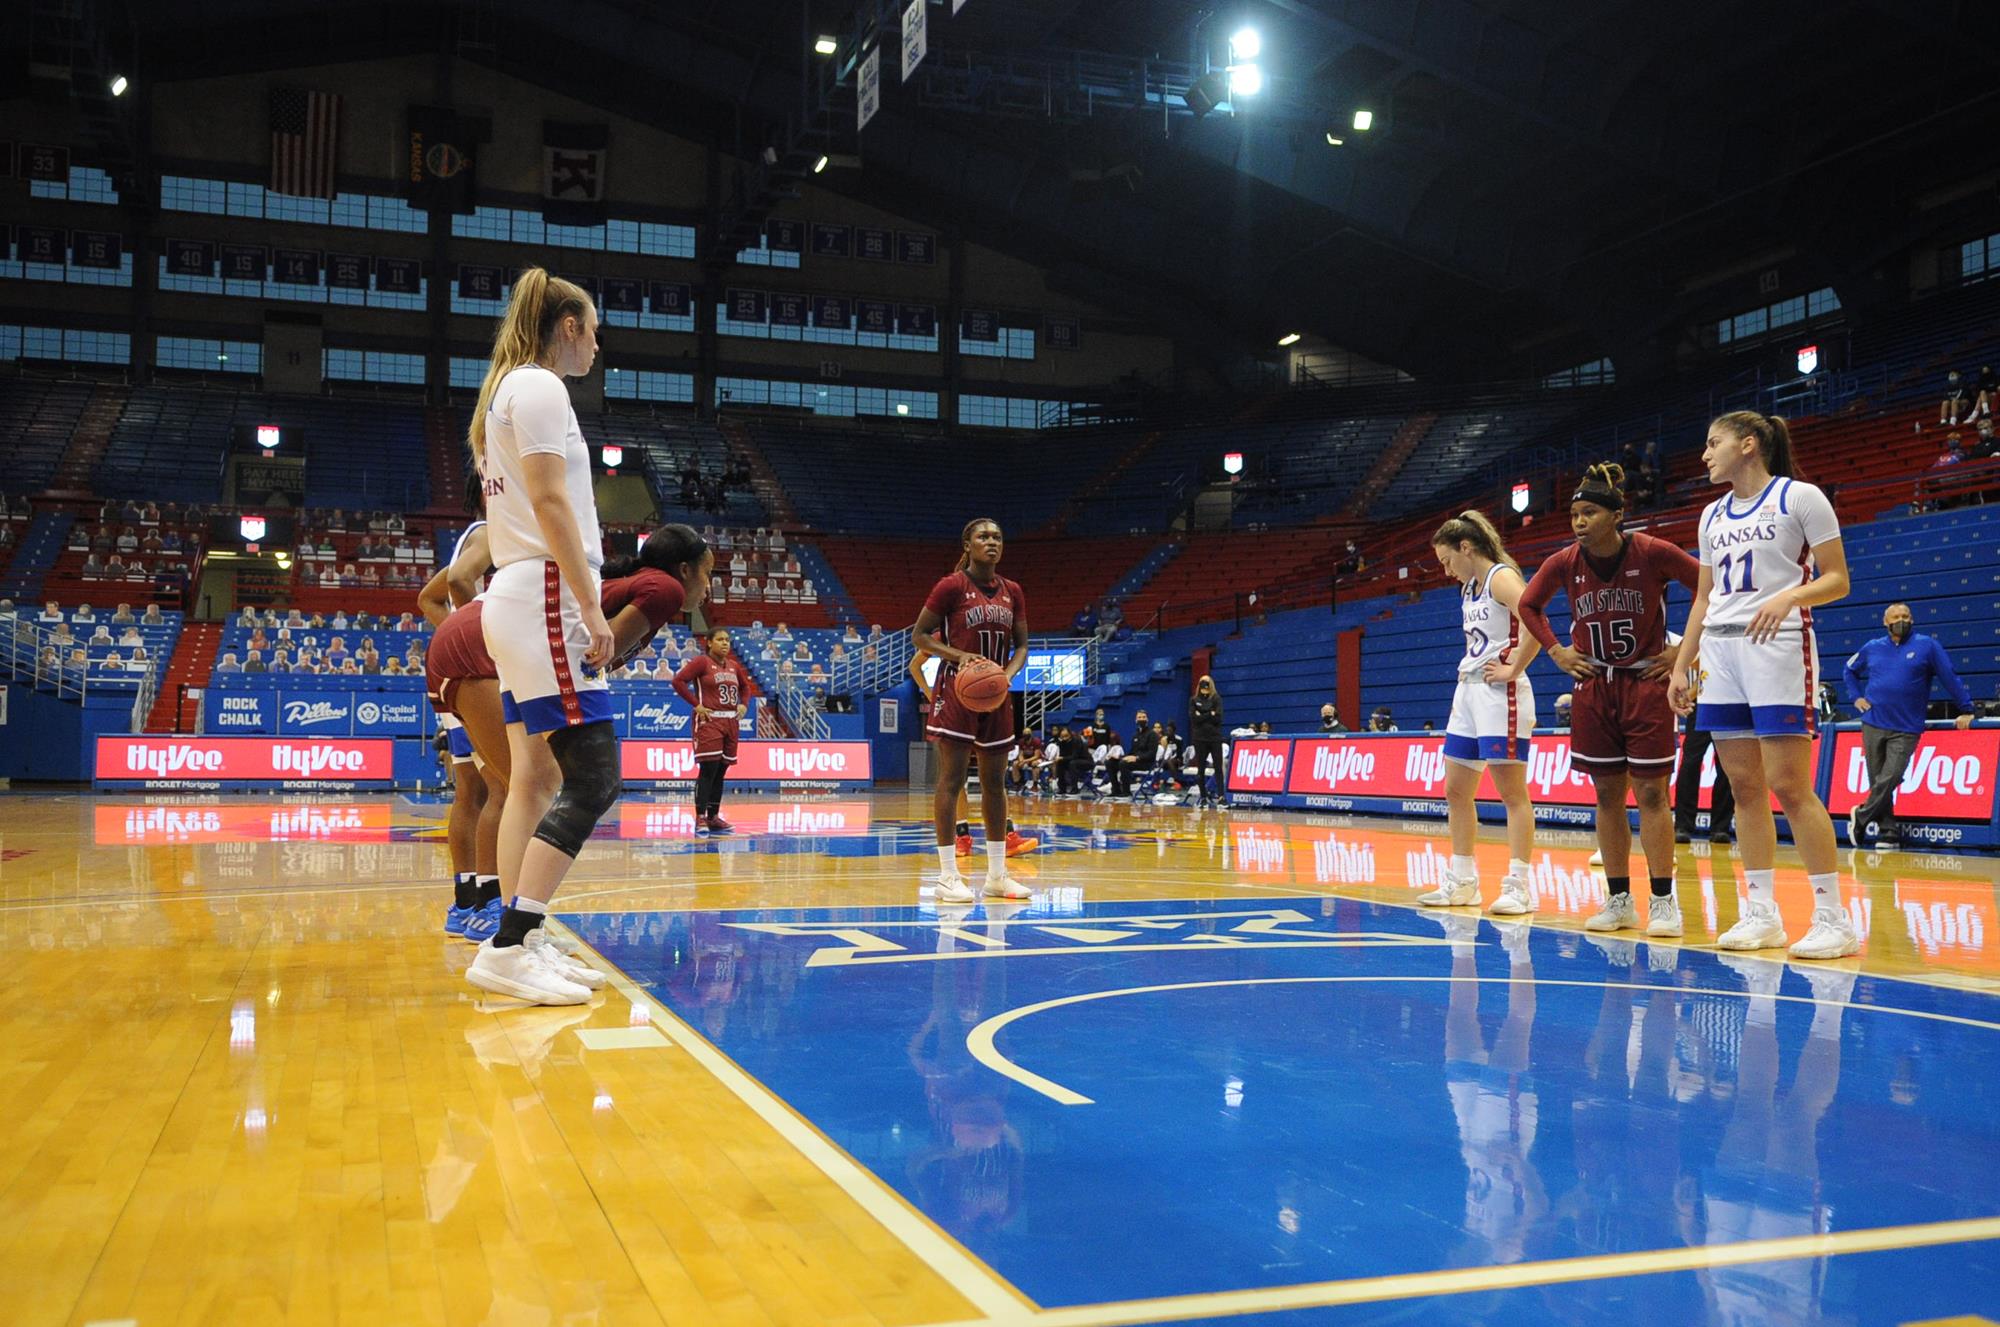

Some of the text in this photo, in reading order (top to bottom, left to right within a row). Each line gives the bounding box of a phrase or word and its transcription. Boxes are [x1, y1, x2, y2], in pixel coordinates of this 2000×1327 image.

[410, 128, 425, 183] KANSAS
[33, 155, 55, 172] 33
[34, 238, 51, 254] 13
[826, 233, 836, 248] 7
[88, 242, 105, 259] 15
[181, 250, 202, 266] 40
[235, 256, 252, 271] 15
[288, 260, 305, 275] 14
[337, 264, 359, 280] 25
[392, 269, 405, 284] 11
[471, 276, 490, 290] 45
[617, 288, 627, 303] 4
[663, 292, 678, 307] 10
[737, 299, 756, 314] 23
[782, 303, 797, 317] 15
[823, 306, 841, 321] 25
[866, 311, 884, 325] 45
[912, 315, 920, 328] 4
[971, 320, 989, 334] 22
[1710, 524, 1776, 551] KANSAS
[1718, 549, 1759, 596] 11
[1576, 588, 1645, 620] NM STATE
[965, 605, 985, 629] NM
[1586, 618, 1637, 661] 15
[978, 630, 1005, 667] 11
[719, 683, 738, 706] 33
[223, 697, 258, 710] ROCK
[382, 704, 416, 715] Capitol
[218, 713, 262, 726] CHALK
[284, 701, 347, 726] Dillons
[382, 713, 416, 723] Federal
[145, 780, 220, 790] ROCKET Mortgage
[283, 780, 355, 790] ROCKET Mortgage
[655, 780, 685, 788] ROCKET
[780, 780, 841, 789] ROCKET Mortgage
[1232, 793, 1273, 806] ROCKET Mortgage
[1306, 796, 1352, 810] ROCKET Mortgage
[1402, 801, 1429, 812] ROCKET
[1533, 807, 1592, 824] CKET Mortgage
[1901, 824, 1962, 843] Mortgage
